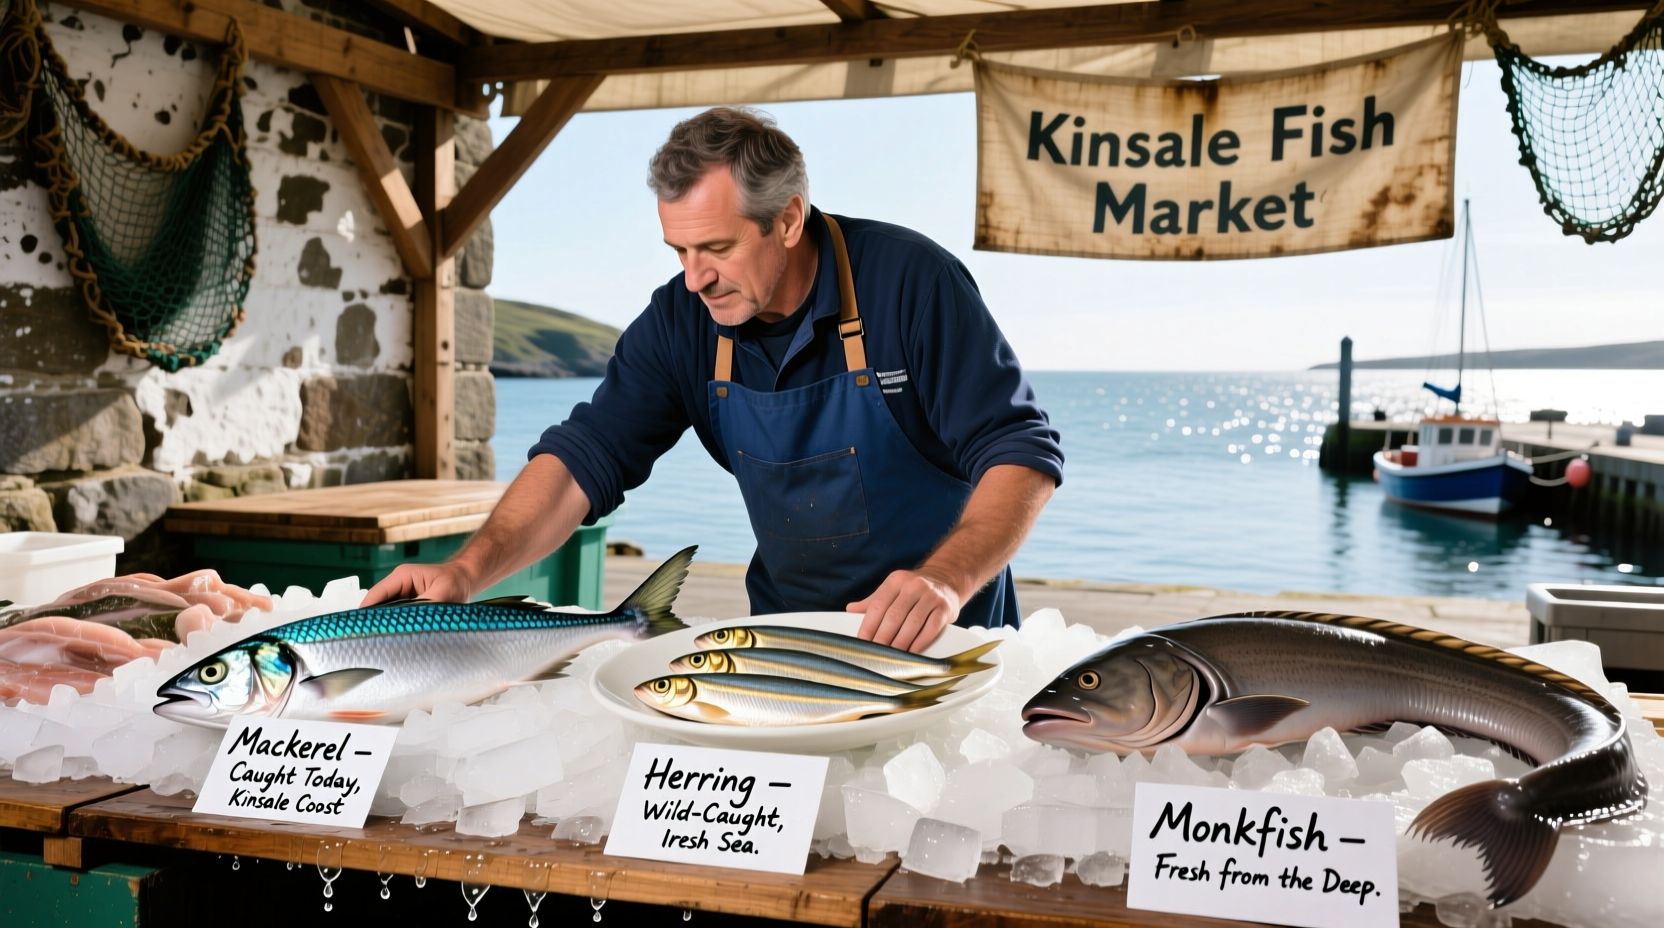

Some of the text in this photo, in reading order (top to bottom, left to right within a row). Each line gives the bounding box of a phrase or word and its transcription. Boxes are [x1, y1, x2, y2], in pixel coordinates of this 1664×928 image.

[1027, 95, 1395, 168] Kinsale Fish
[1093, 181, 1315, 235] Market
[227, 726, 352, 762] Mackerel
[227, 787, 290, 811] Kinsale
[229, 760, 361, 798] Caught Today,
[643, 757, 756, 809] Herring
[643, 799, 784, 837] Wild-Caught,
[1149, 801, 1329, 858] Monkfish
[661, 828, 760, 855] Iresh Sea.
[1154, 852, 1381, 906] Fresh from the Deep.
